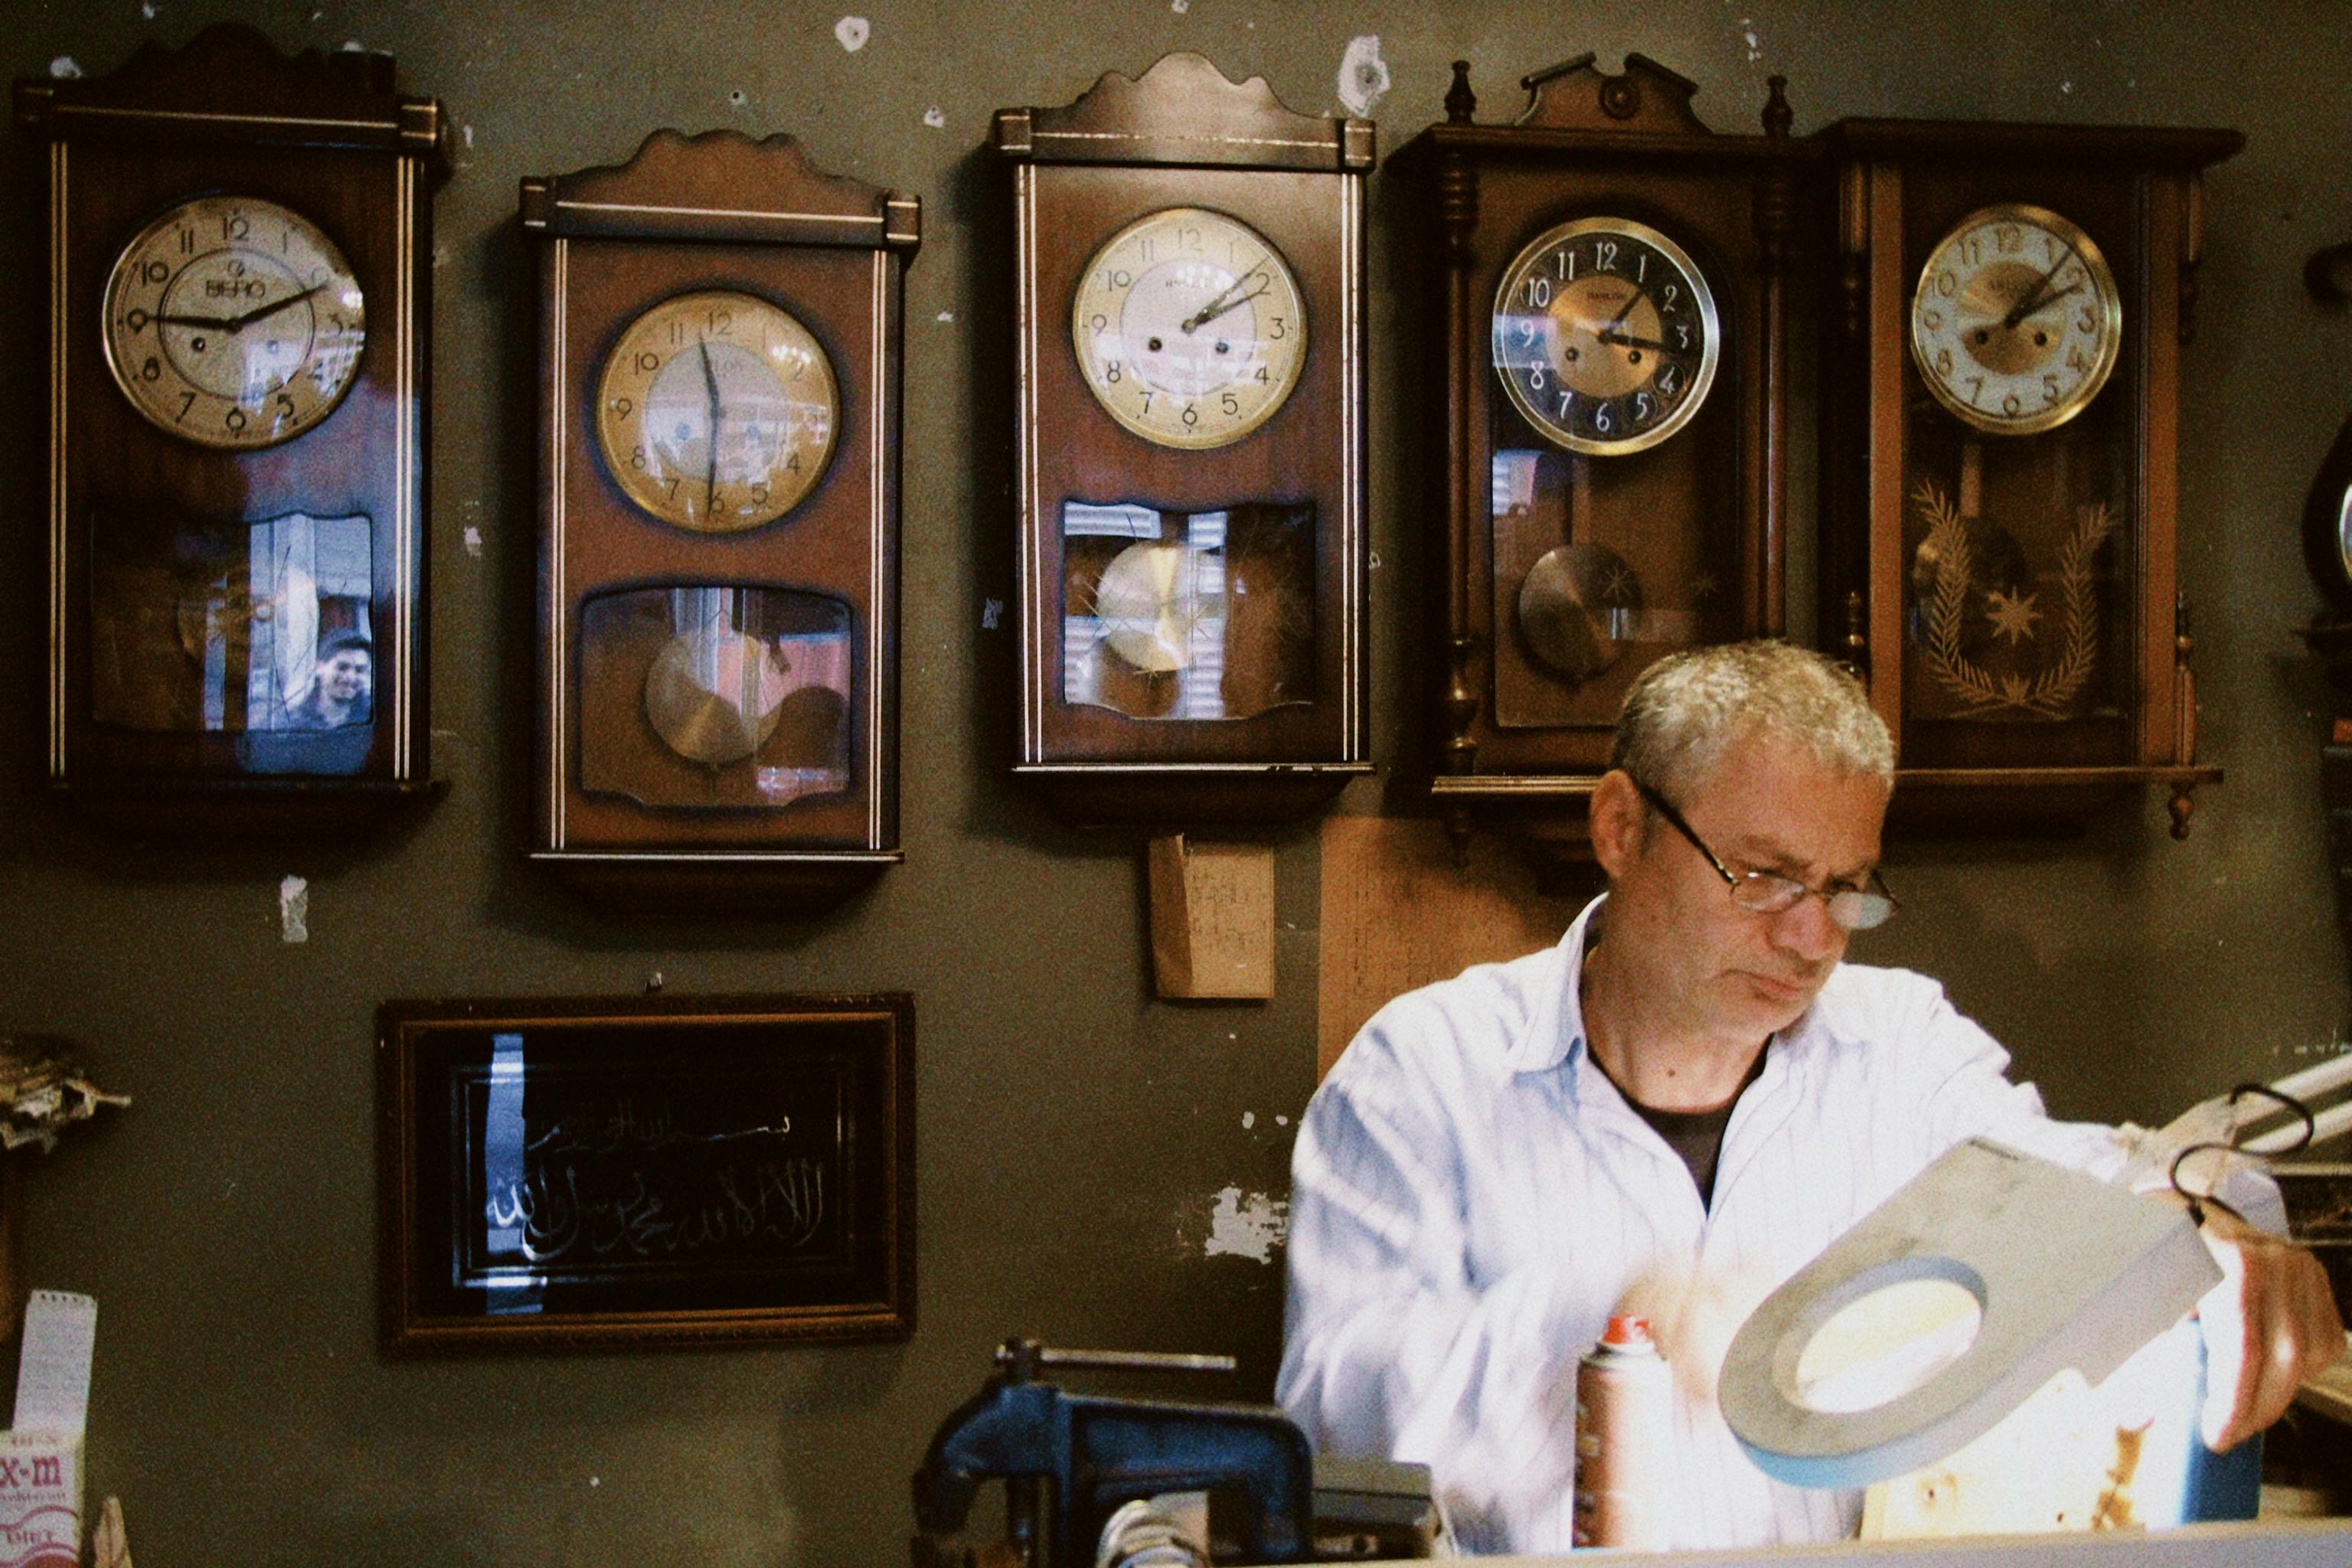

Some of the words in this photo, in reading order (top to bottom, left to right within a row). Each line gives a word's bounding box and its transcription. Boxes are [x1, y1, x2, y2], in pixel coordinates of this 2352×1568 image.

[222, 216, 250, 241] 12
[1178, 229, 1202, 252] 12
[1141, 239, 1155, 262] 11
[1596, 241, 1618, 271] 12
[141, 261, 169, 287] 10
[1558, 251, 1575, 280] 11
[1638, 254, 1647, 283] 1
[1107, 270, 1132, 292] 10
[1255, 272, 1272, 296] 2
[1527, 276, 1550, 308] 10
[1662, 285, 1677, 313] 2
[707, 312, 733, 335] 12
[1091, 314, 1108, 337] 9
[1269, 317, 1285, 340] 3
[1520, 318, 1535, 348] 9
[635, 352, 659, 376] 10
[1106, 359, 1122, 383] 8
[1253, 366, 1271, 386] 4
[1530, 361, 1545, 390] 8
[1658, 365, 1676, 395] 4
[175, 391, 196, 424] 7
[616, 397, 633, 420] 9
[1138, 391, 1155, 414] 7
[1181, 403, 1198, 426] 6
[1221, 394, 1239, 416] 5
[1559, 390, 1573, 420] 7
[1635, 392, 1648, 421] 5
[1596, 402, 1610, 432] 6
[665, 478, 681, 501] 7
